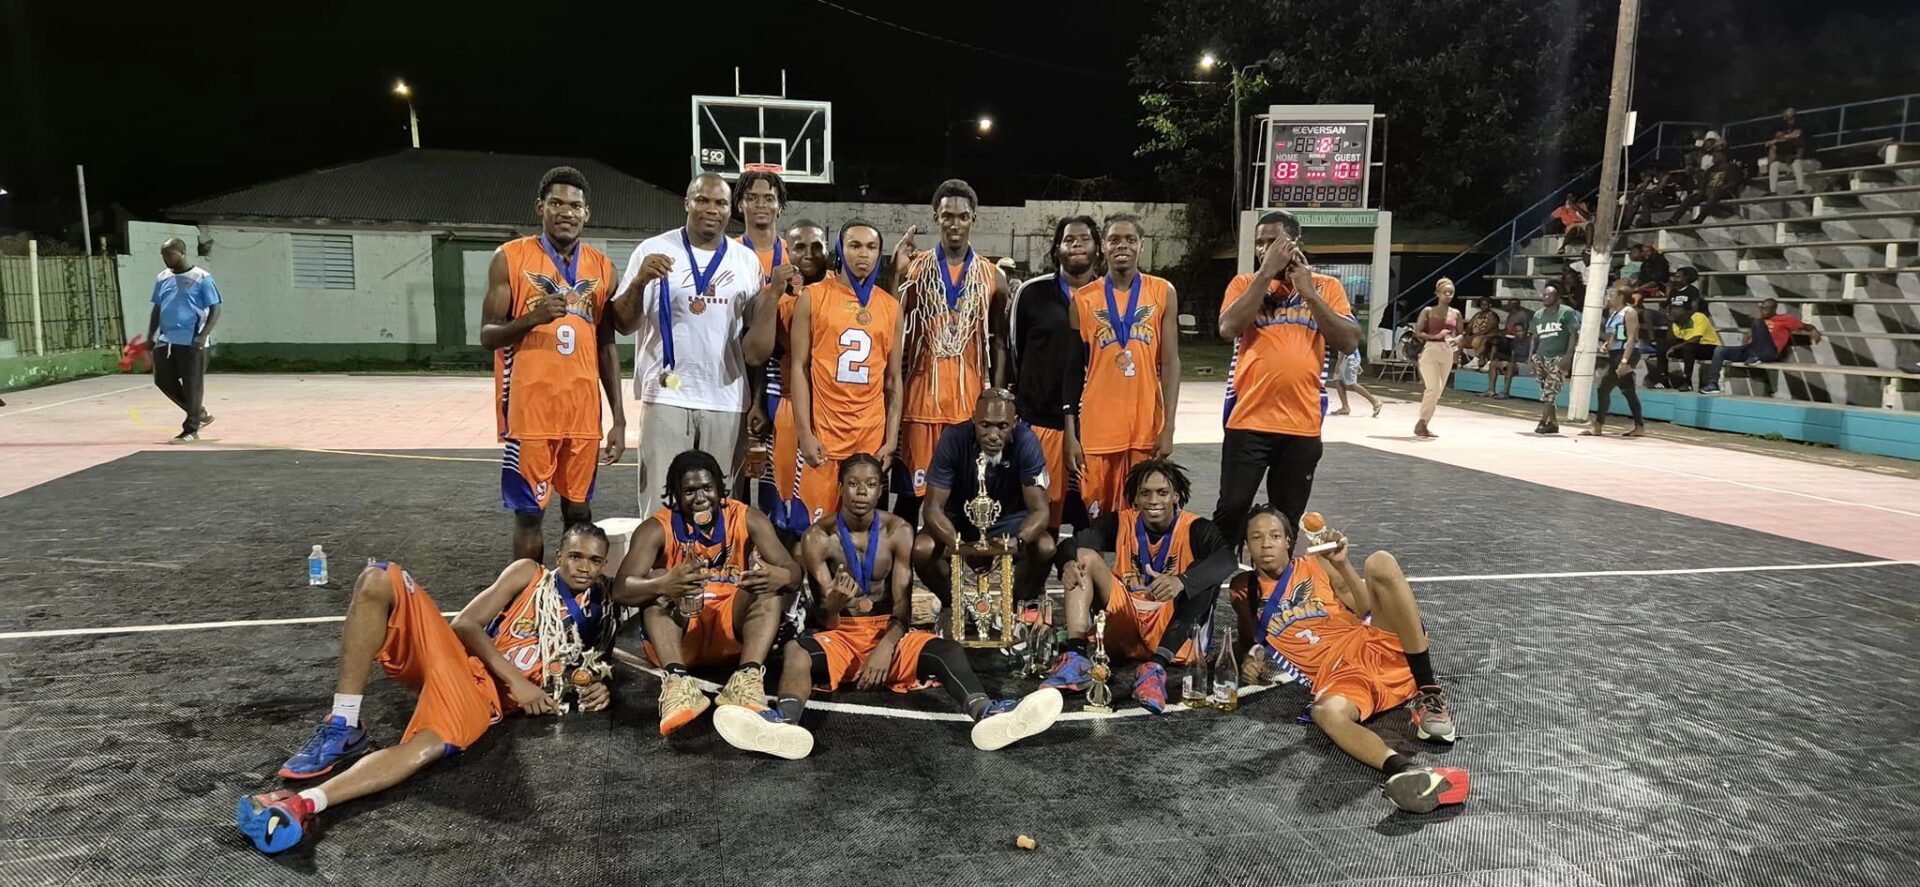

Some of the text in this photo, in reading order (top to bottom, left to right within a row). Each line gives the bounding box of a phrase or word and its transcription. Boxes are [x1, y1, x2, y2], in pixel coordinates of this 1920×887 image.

[1301, 126, 1346, 134] EVERSAN
[1334, 154, 1361, 162] GUEST
[1276, 162, 1299, 179] 83
[556, 324, 576, 355] 9
[835, 327, 873, 385] 2
[914, 468, 925, 488] 6
[536, 481, 547, 501] 9
